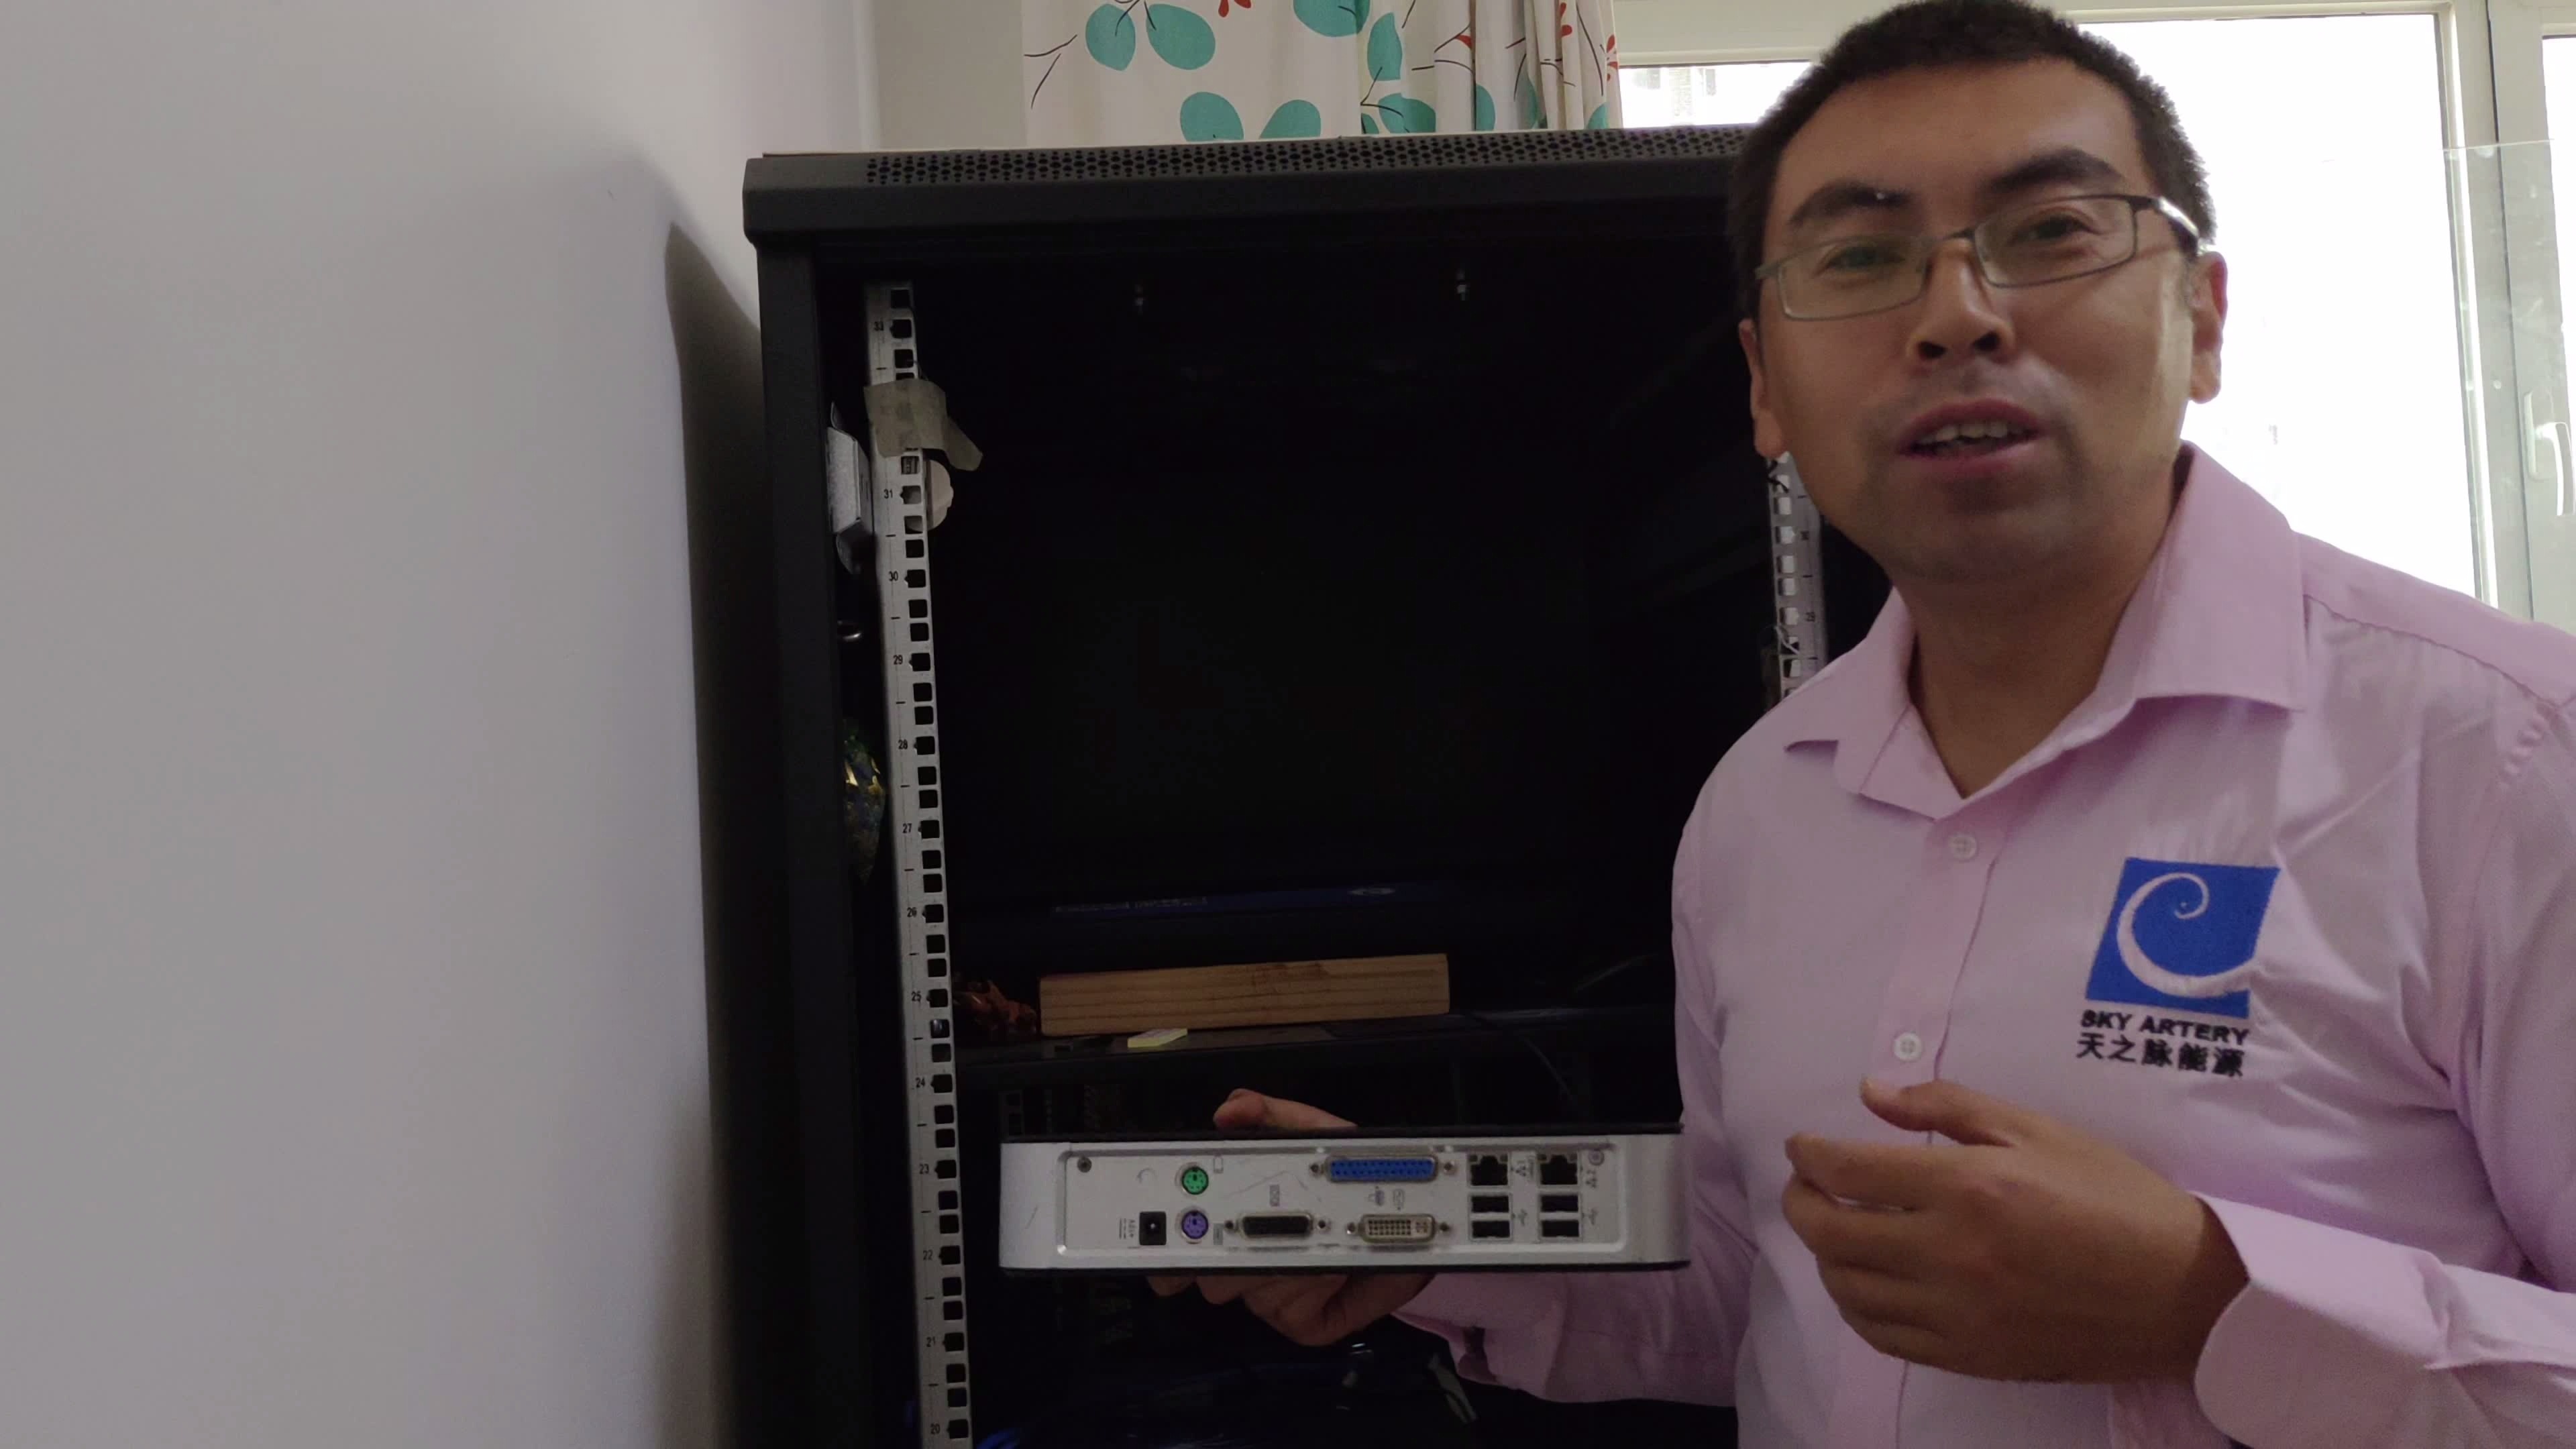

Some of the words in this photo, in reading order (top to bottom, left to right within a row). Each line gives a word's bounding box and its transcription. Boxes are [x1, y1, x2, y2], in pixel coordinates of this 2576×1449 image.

[883, 488, 893, 500] 31
[888, 570, 899, 582] 30
[893, 654, 904, 665] 29
[898, 739, 908, 750] 28
[902, 822, 912, 834] 27
[906, 906, 918, 918] 26
[911, 990, 922, 1003] 25
[2081, 1009, 2132, 1030] SKY
[2139, 1016, 2249, 1045] ARTERY
[915, 1077, 926, 1089] 24
[918, 1163, 930, 1175] 23
[922, 1249, 933, 1261] 22
[926, 1336, 936, 1348] 21
